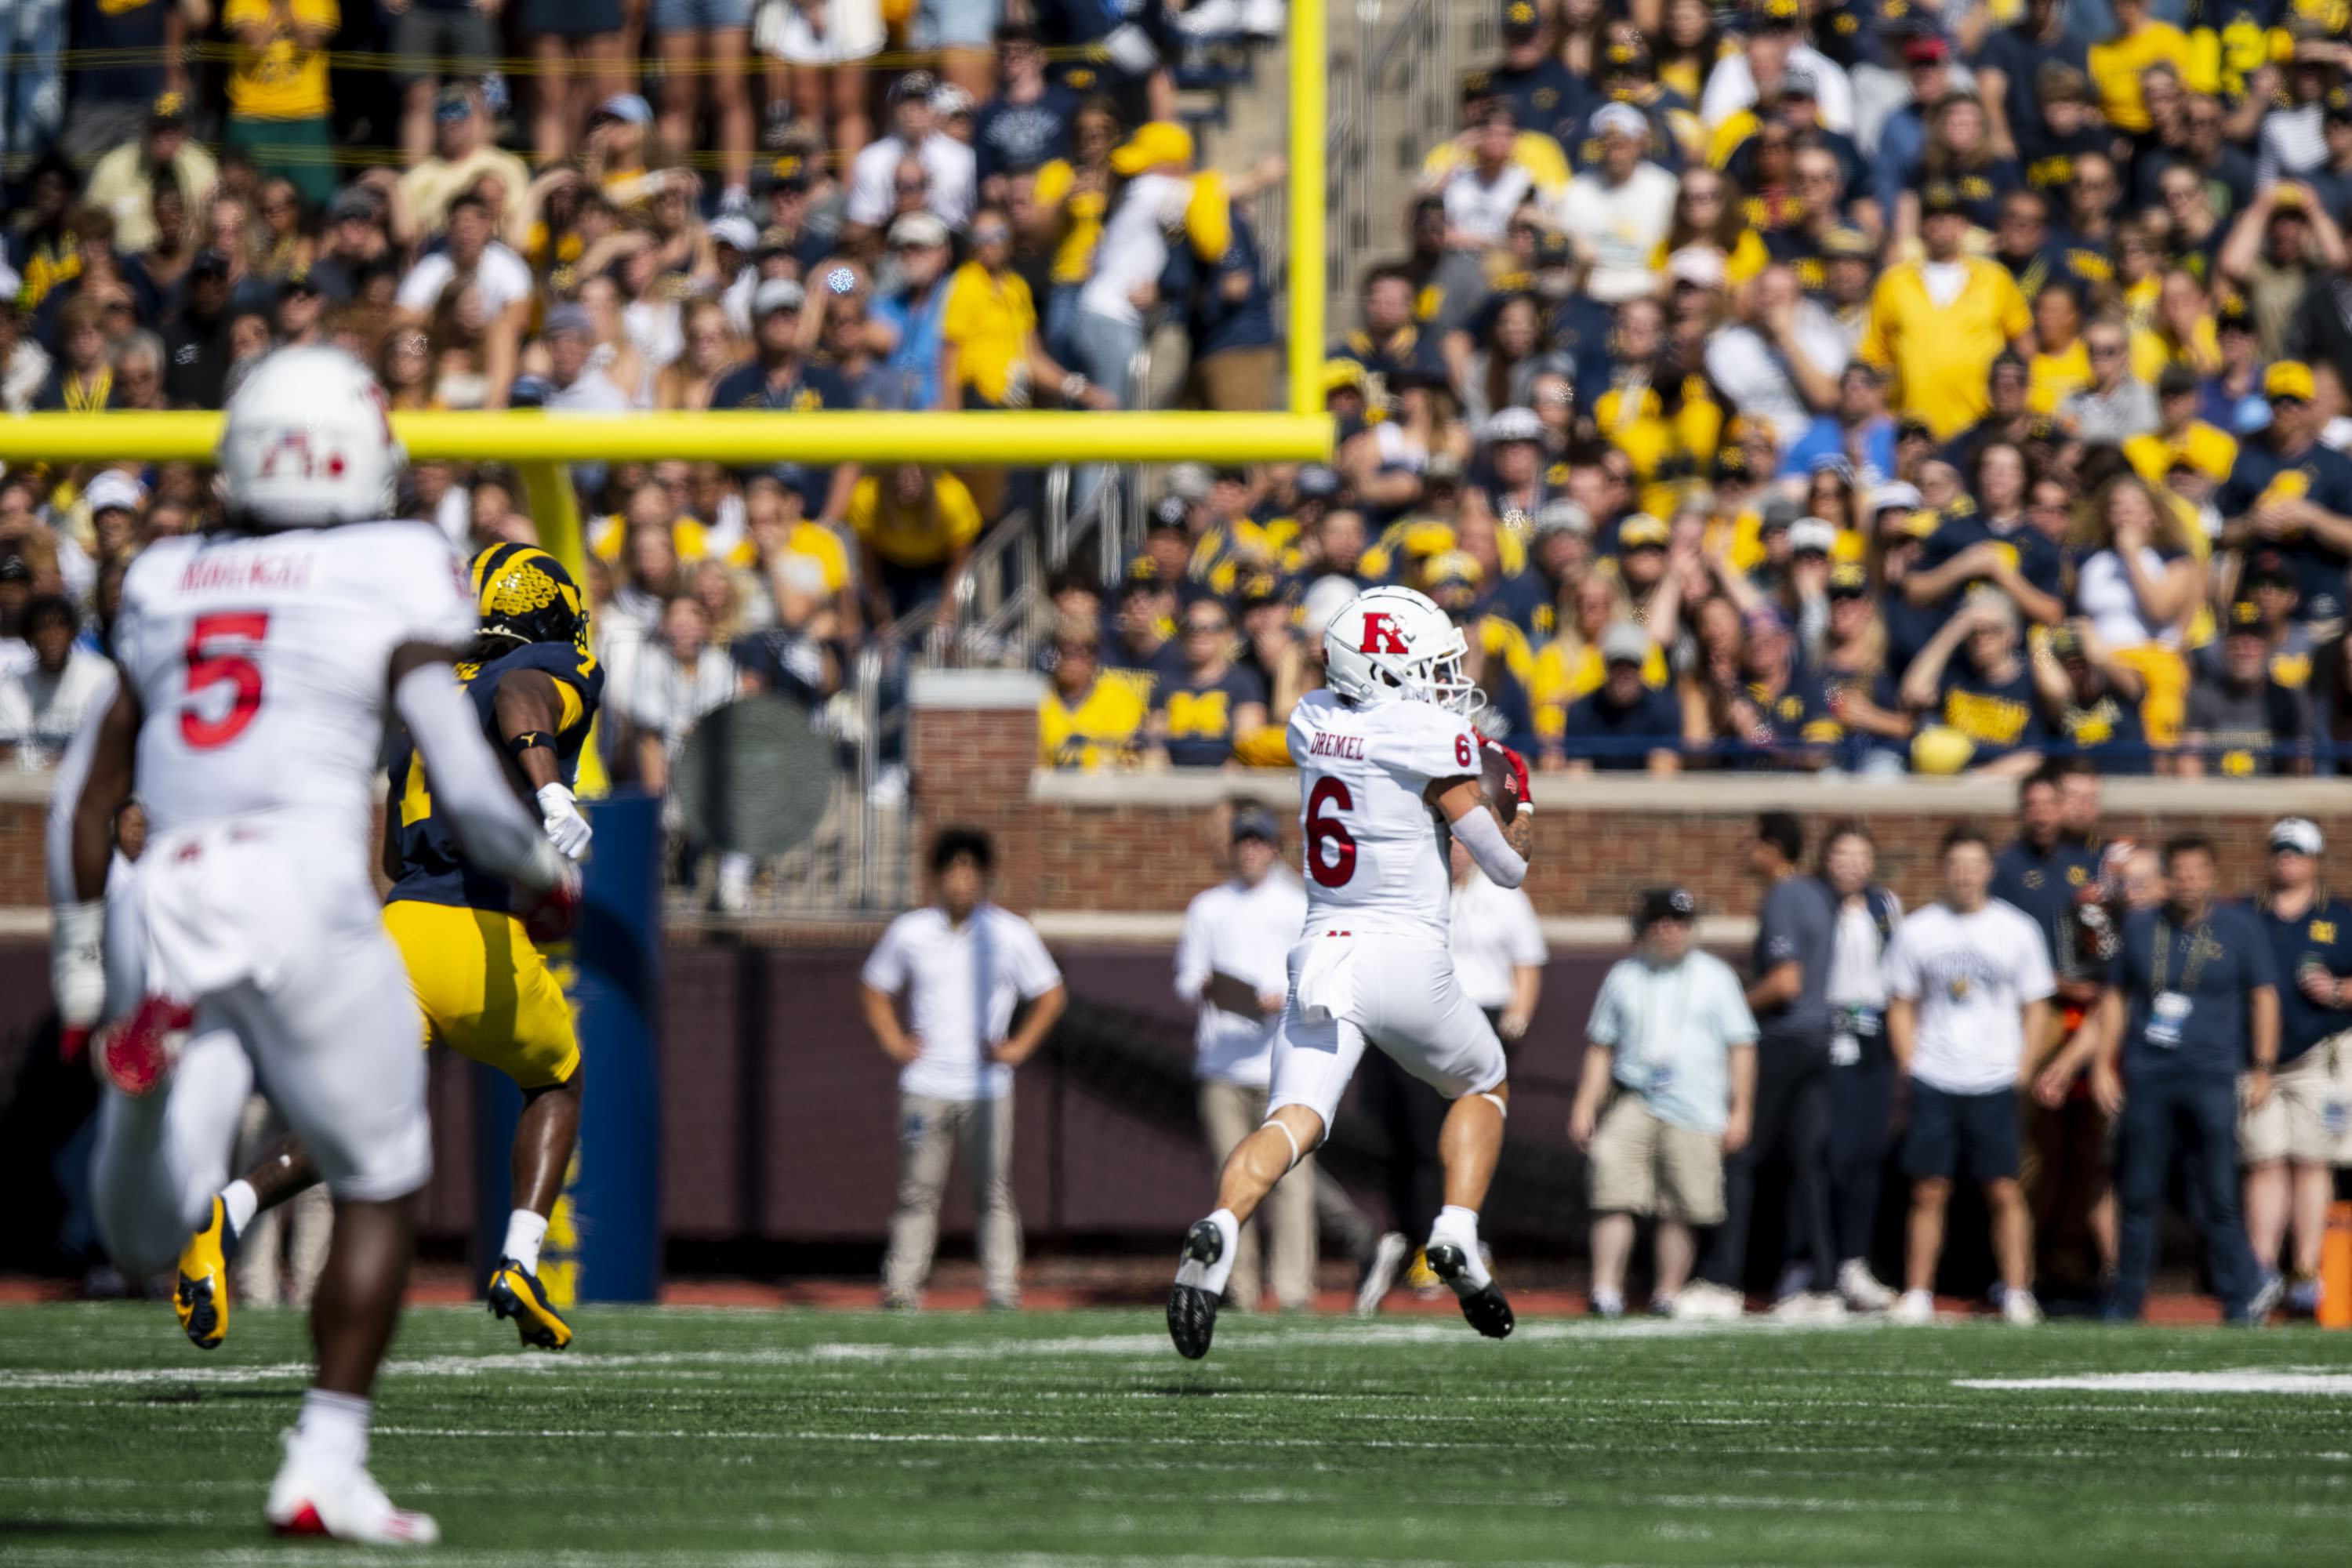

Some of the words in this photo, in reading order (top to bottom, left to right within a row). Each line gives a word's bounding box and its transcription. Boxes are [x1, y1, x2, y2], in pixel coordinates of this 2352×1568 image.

[180, 611, 268, 750] 5
[1310, 731, 1364, 760] DREMEL
[1455, 733, 1471, 767] 6
[1306, 776, 1356, 887] 6
